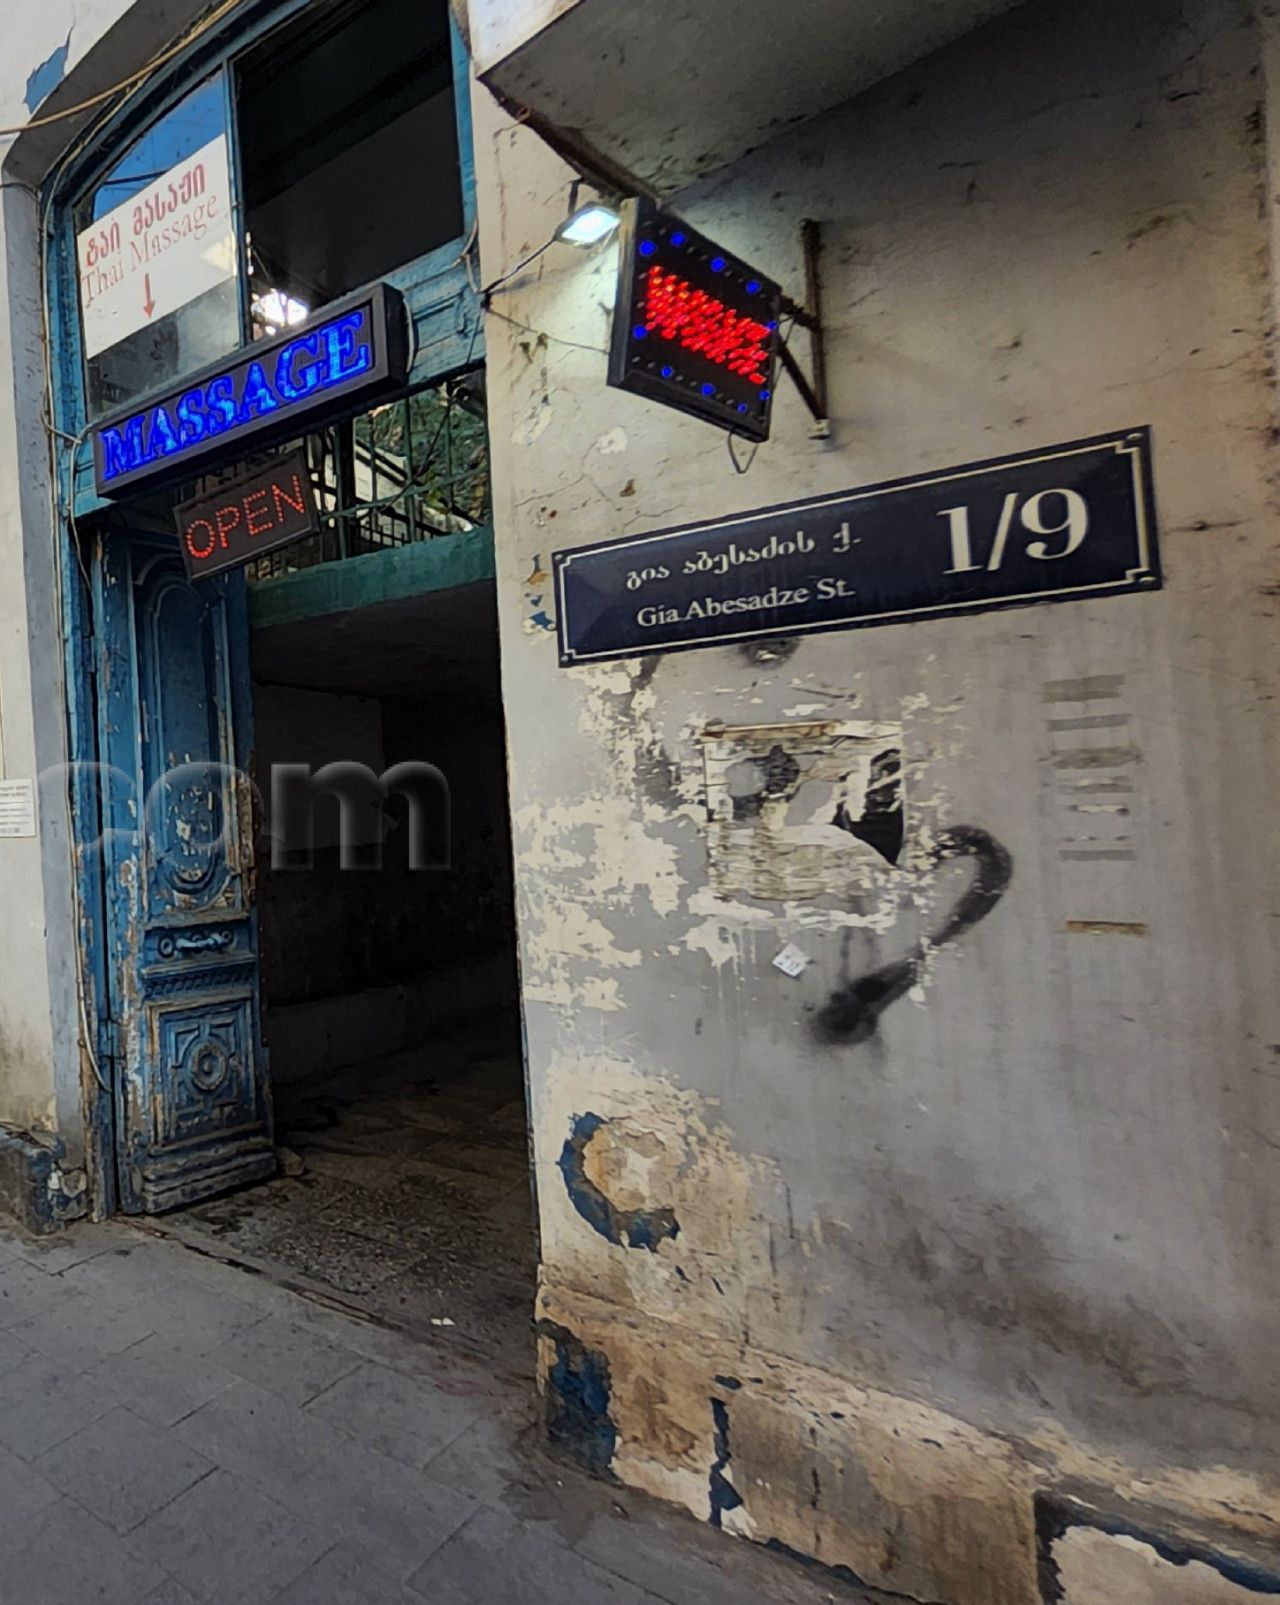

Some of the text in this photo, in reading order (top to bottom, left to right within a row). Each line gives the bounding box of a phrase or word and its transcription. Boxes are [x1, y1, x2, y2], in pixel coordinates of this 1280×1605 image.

[132, 163, 206, 235] მასაჟი
[82, 194, 218, 309] Thai Massage
[103, 311, 369, 482] MASSAGE
[185, 474, 306, 559] OPEN
[936, 487, 1089, 575] 1/9
[626, 564, 671, 590] გია
[682, 530, 816, 574] აბესაძის
[637, 604, 680, 627] Gia
[683, 586, 810, 621] Abesadze
